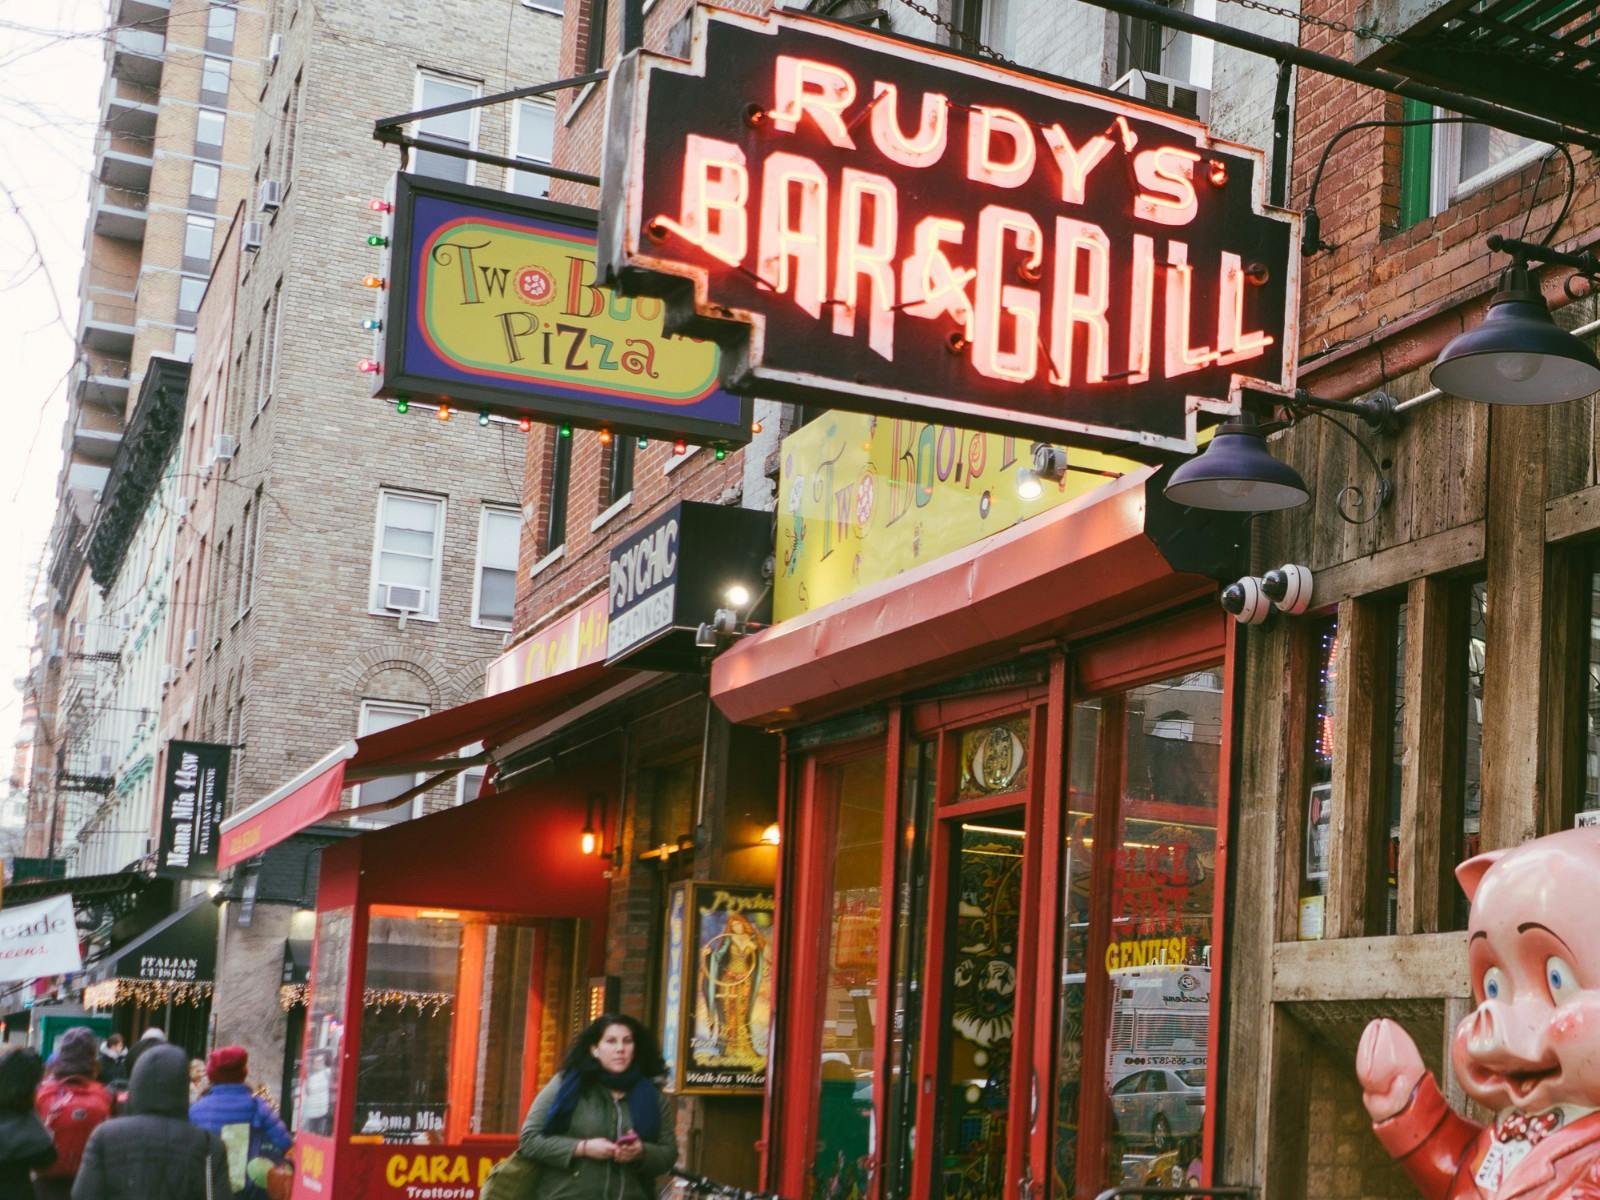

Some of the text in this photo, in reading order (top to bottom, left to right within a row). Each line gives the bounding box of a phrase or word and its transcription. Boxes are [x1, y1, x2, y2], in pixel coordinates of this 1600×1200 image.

[772, 54, 1201, 227] RUDY'S
[495, 311, 660, 379] Pizza
[609, 519, 678, 614] PSYCHIC
[140, 957, 198, 969] ITALIAN
[140, 967, 197, 979] CUISINE
[386, 1154, 470, 1188] CARA
[406, 1186, 475, 1200] Trattoria
